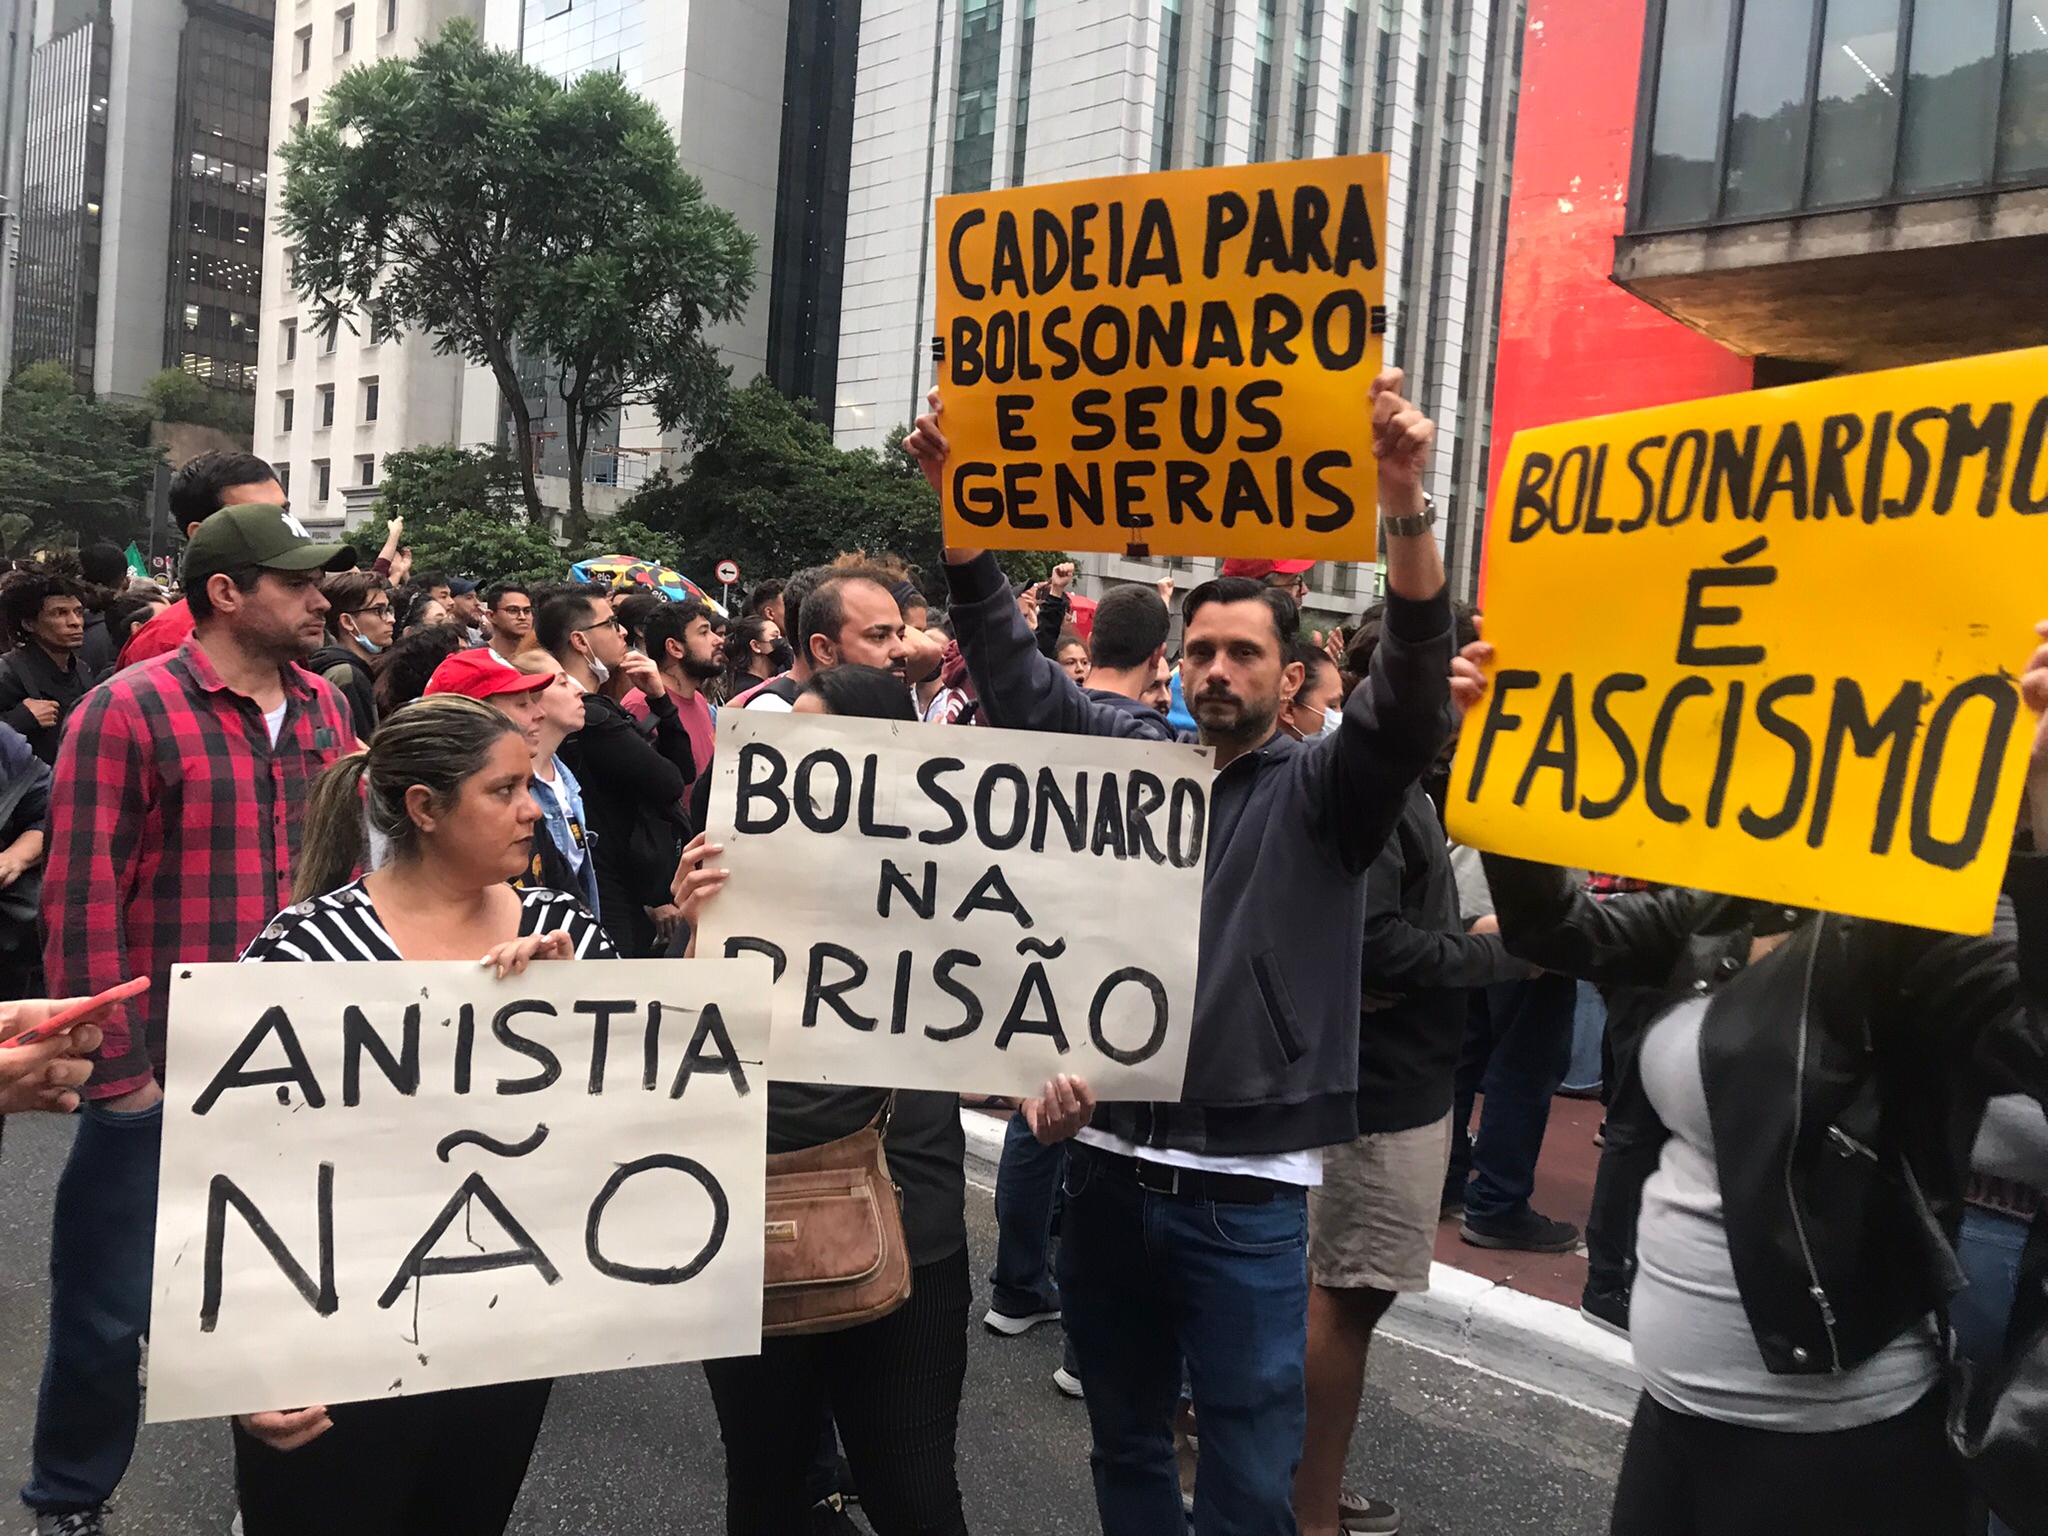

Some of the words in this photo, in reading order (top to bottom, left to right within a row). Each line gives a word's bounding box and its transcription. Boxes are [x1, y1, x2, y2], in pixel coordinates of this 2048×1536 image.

[948, 198, 1183, 301] CADEIA
[1203, 183, 1378, 279] PARA
[951, 288, 1368, 387] BOLSONARO
[996, 394, 1037, 452] E
[1071, 379, 1283, 454] SEUS
[1510, 396, 2048, 543] BOLSONARISMO
[952, 449, 1355, 533] GENERAIS
[1676, 535, 1778, 667] É
[733, 742, 1206, 869] BOLSONARO
[1467, 669, 2020, 871] FASCISMO
[876, 858, 1034, 929] NA
[191, 999, 750, 1116] ANISTIA
[200, 1122, 730, 1333] NÃO
